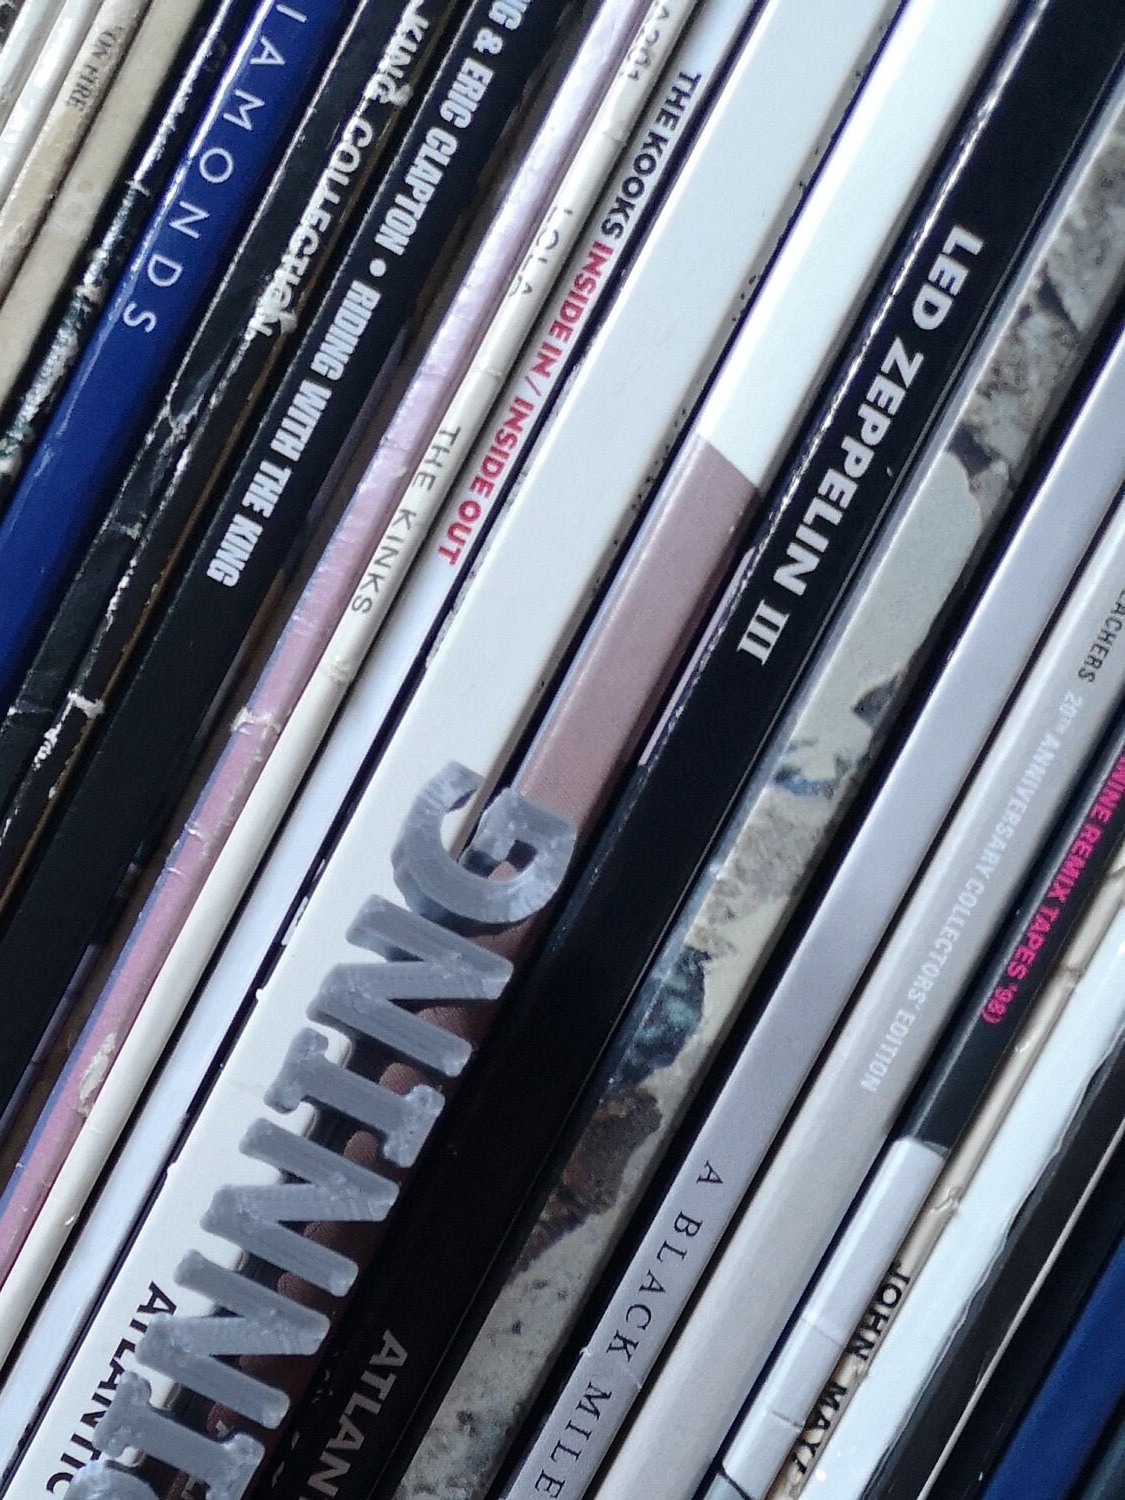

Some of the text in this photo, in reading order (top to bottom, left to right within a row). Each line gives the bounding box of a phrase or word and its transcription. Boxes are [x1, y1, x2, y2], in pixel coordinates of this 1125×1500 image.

[470, 26, 506, 60] &
[436, 55, 494, 129] ERIC
[651, 64, 702, 134] THE
[373, 126, 459, 256] CLAPTON
[596, 130, 669, 243] KOOKS
[308, 278, 383, 383] RIDING
[545, 239, 614, 344] INSIDE
[527, 340, 562, 380] IN
[268, 377, 331, 462] WITH
[408, 418, 460, 495] THE
[466, 394, 535, 499] INSIDE
[733, 223, 984, 666] LED ZEPPELIN III
[240, 456, 292, 517] THE
[203, 511, 264, 590] KING
[345, 505, 416, 618] KINKS
[432, 495, 483, 566] OUT
[969, 731, 1062, 879] ANNIVERSARY
[1043, 821, 1102, 905] REMIX
[1002, 900, 1060, 982] TAPES
[856, 1006, 916, 1094] EDITION
[694, 1159, 729, 1194] A
[603, 1209, 703, 1366] BLACK
[842, 1258, 915, 1361] JOHN
